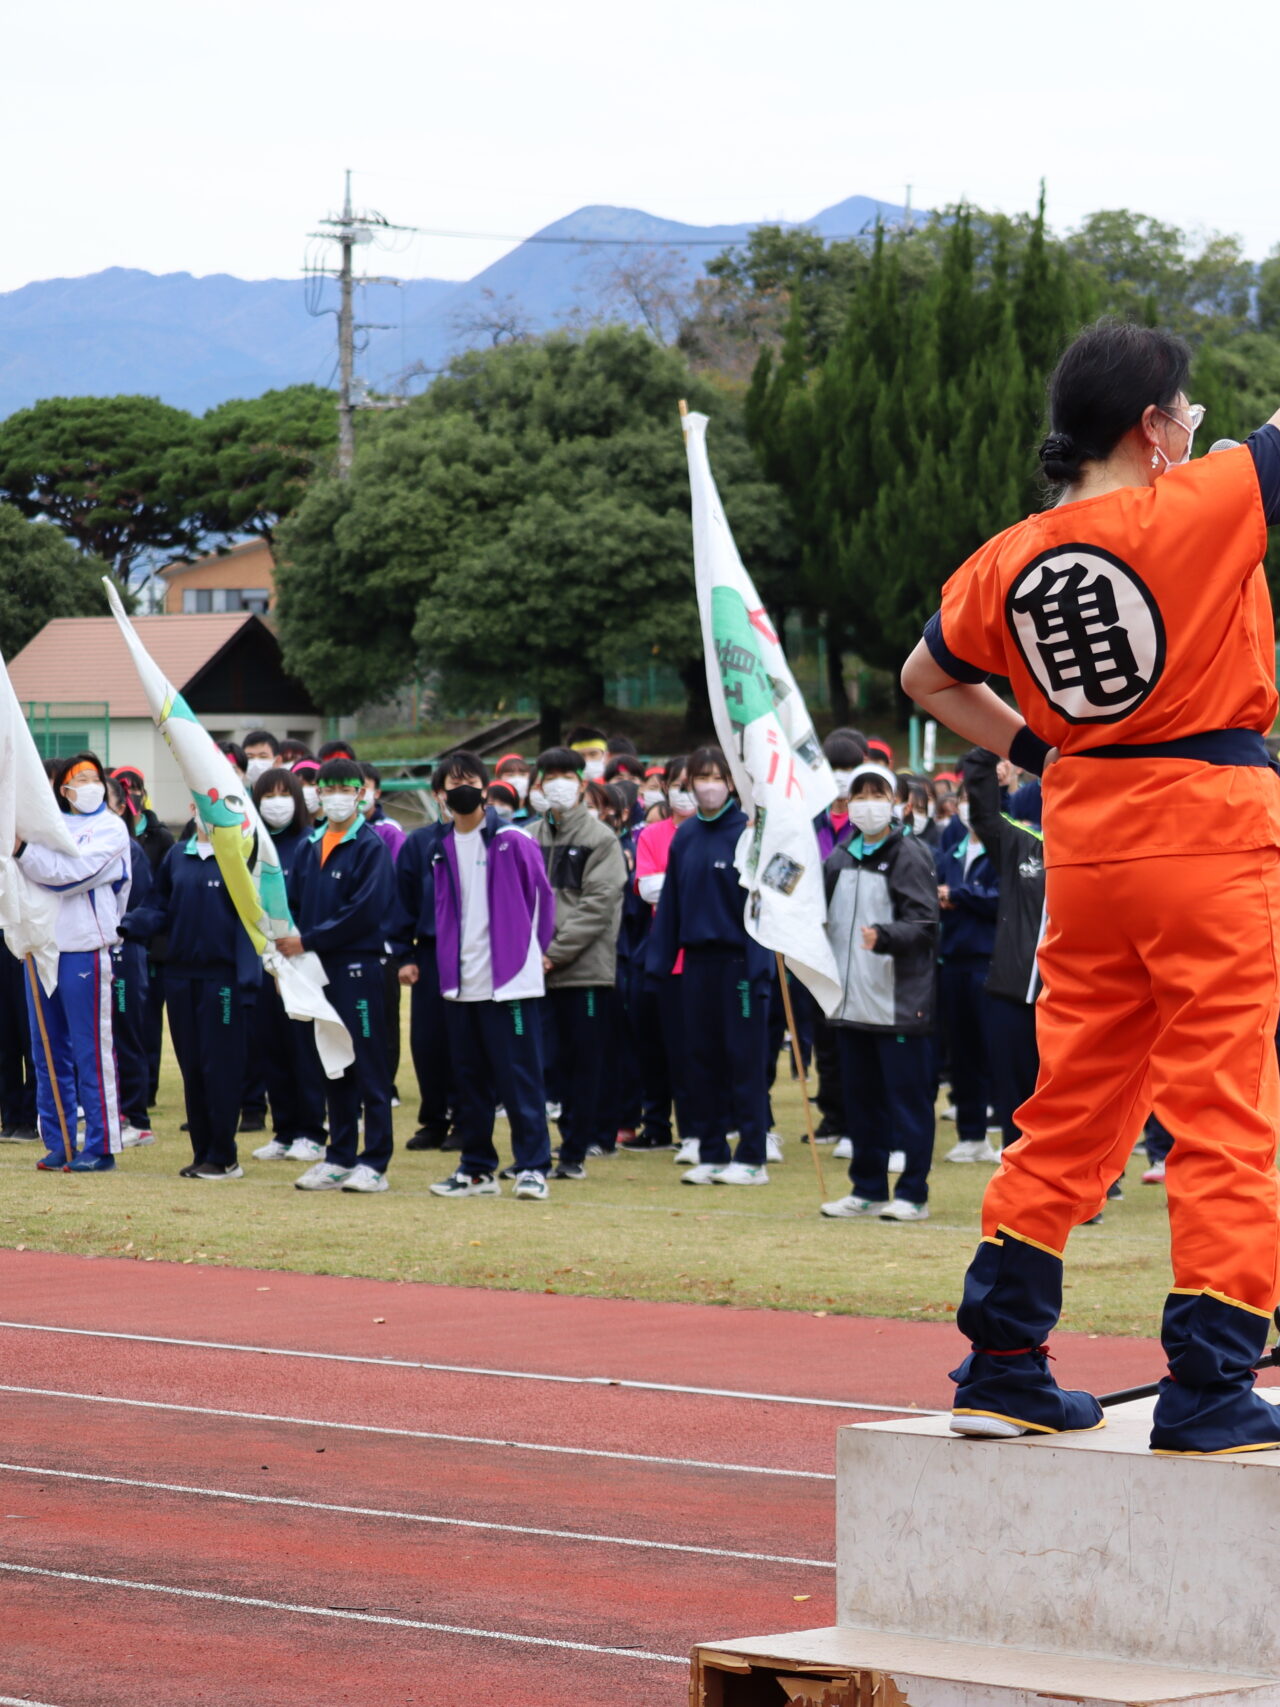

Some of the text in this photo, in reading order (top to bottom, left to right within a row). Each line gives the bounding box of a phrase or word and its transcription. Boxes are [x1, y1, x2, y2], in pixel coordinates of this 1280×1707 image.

[1013, 562, 1148, 707] 亀
[218, 986, 232, 1024] maeichi
[356, 1000, 370, 1038] maeichi
